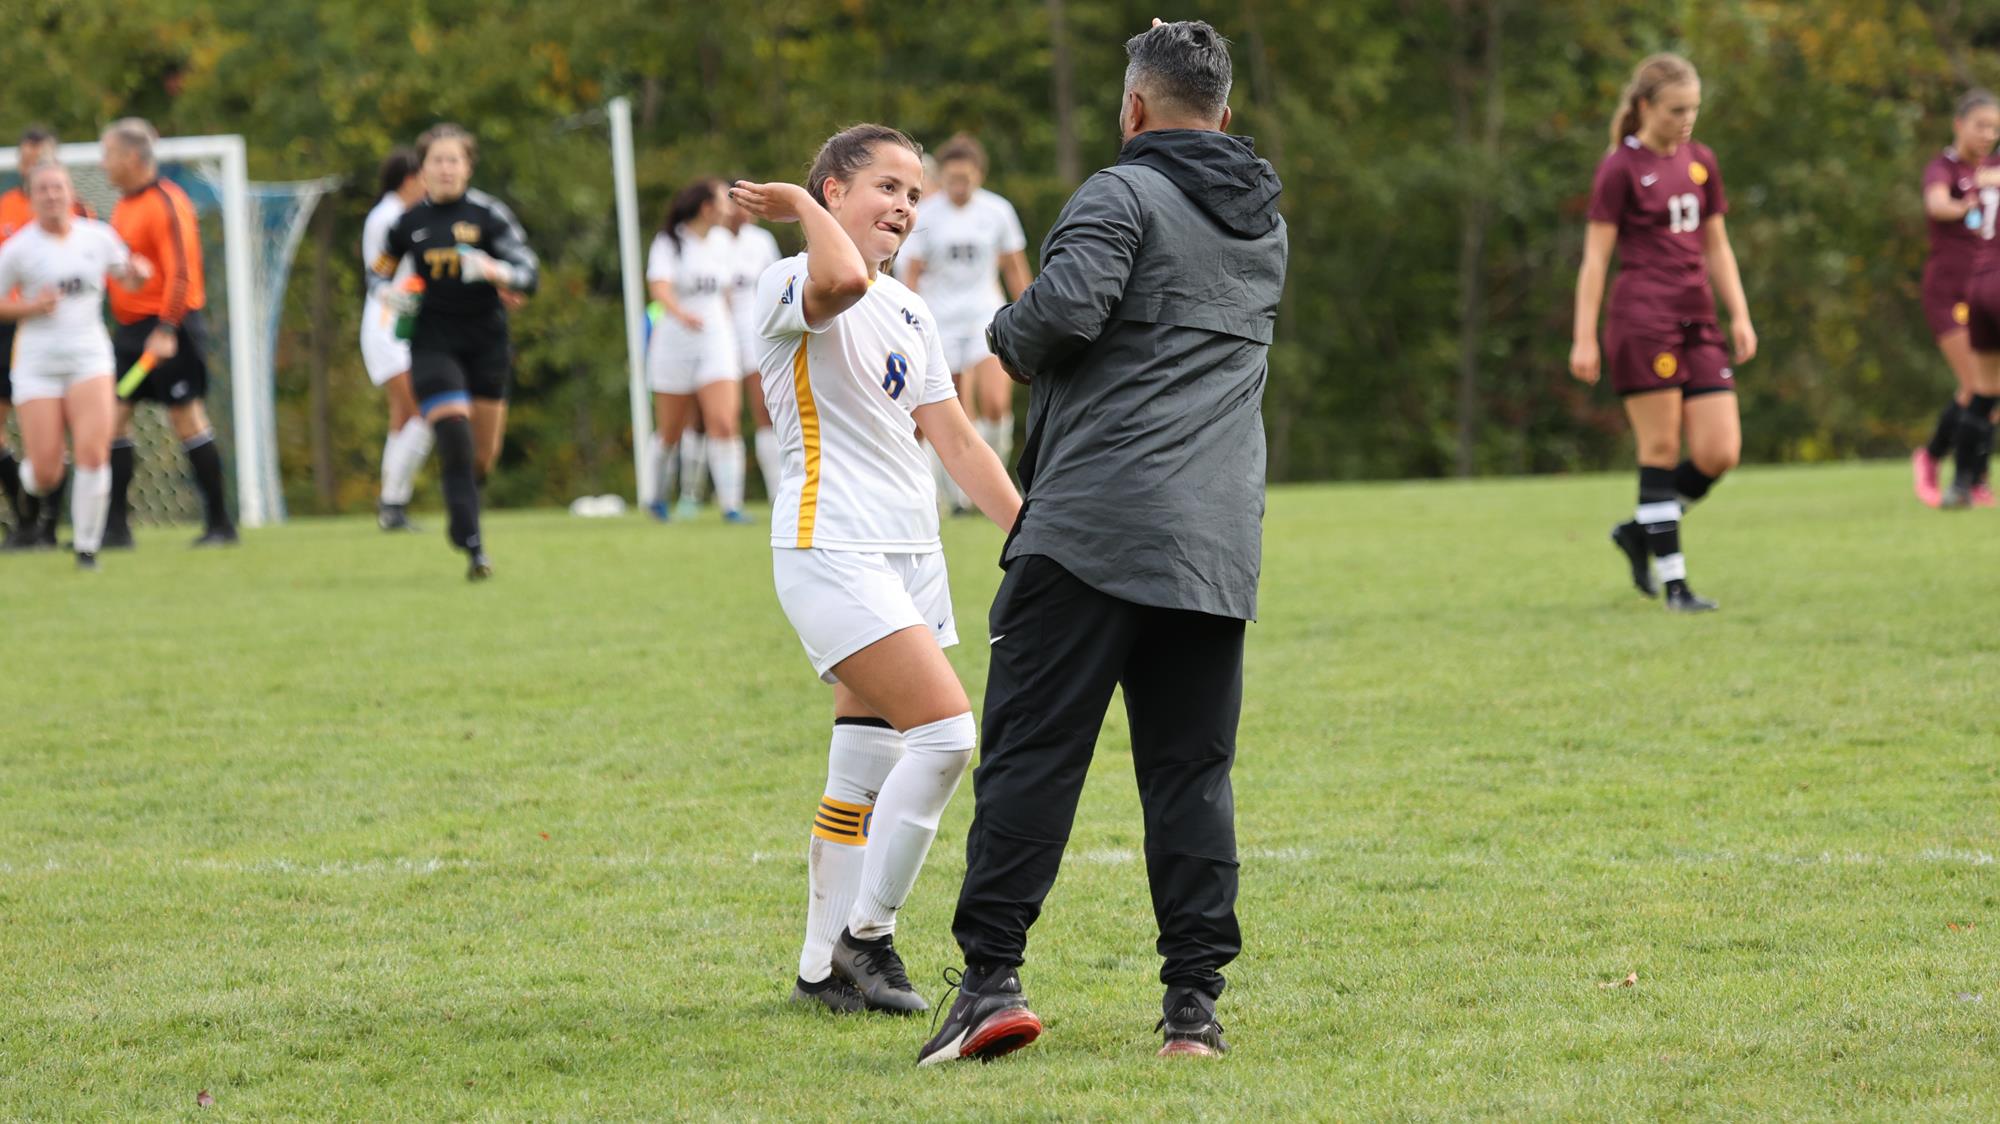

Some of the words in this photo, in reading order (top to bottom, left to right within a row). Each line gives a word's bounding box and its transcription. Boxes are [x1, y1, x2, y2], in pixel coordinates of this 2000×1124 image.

[1667, 192, 1700, 234] 13
[423, 247, 461, 280] 77
[881, 351, 908, 401] 8
